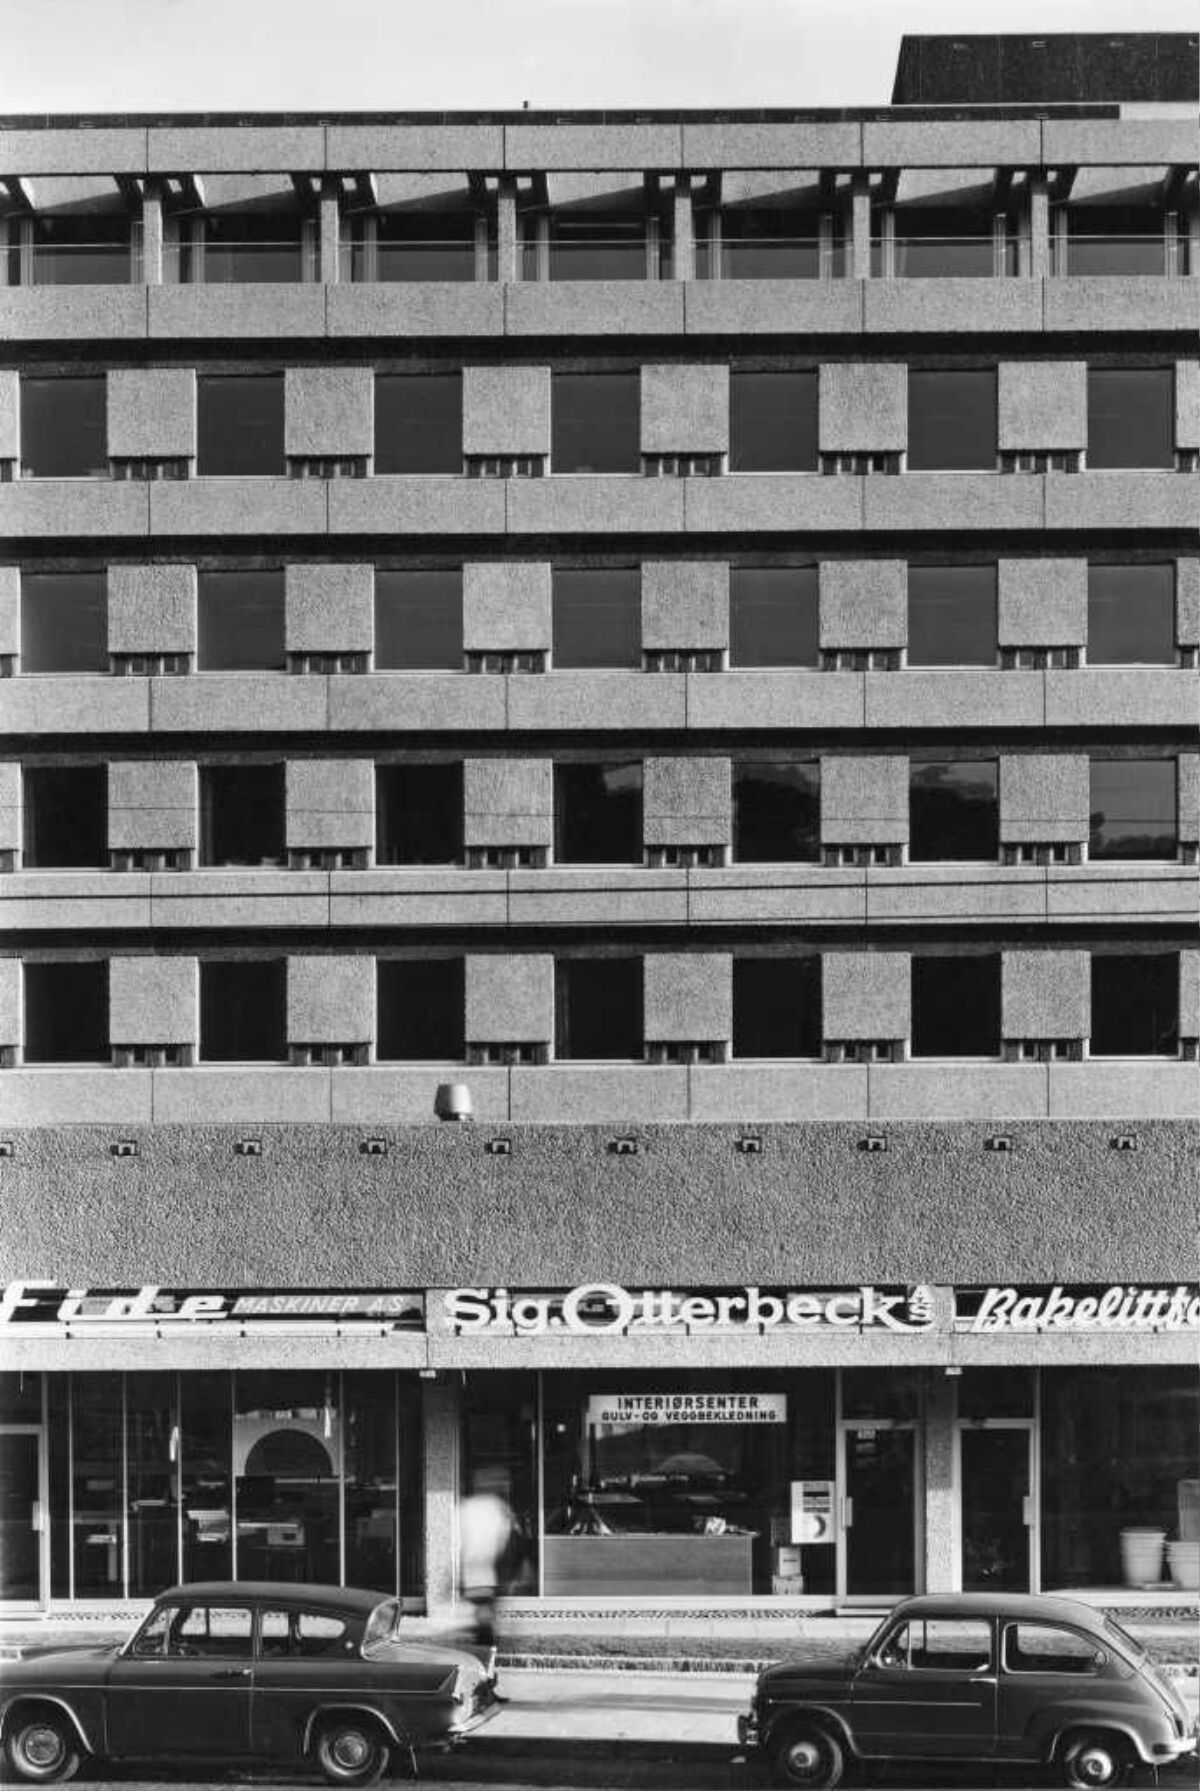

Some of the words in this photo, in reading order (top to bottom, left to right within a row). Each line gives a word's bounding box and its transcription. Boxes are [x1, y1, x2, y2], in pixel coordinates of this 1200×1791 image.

[232, 1296, 360, 1314] MASKINER
[445, 1288, 563, 1335] Sig.
[562, 1283, 935, 1335] Otterbeck
[617, 1397, 759, 1409] INTERIØRSENTER
